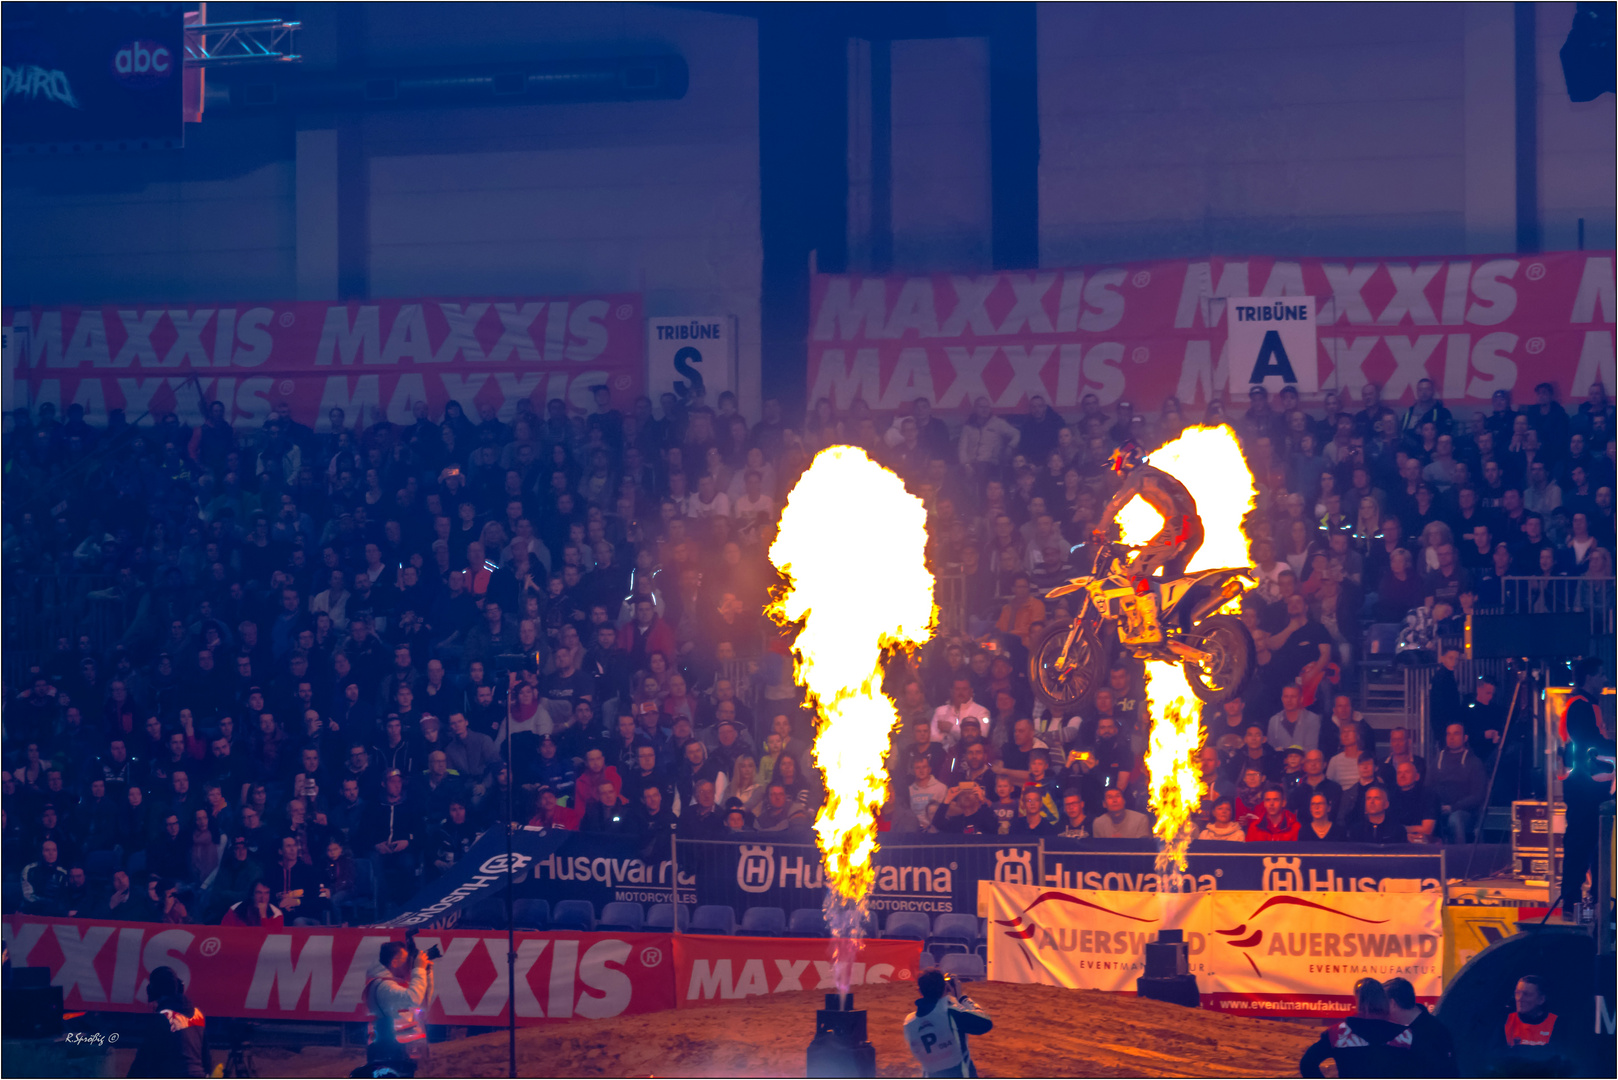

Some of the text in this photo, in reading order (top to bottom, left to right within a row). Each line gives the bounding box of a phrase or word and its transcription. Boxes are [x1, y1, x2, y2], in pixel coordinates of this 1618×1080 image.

[115, 41, 169, 73] abc
[813, 268, 1128, 341] MAXXIS
[1236, 301, 1308, 321] TRIBÜNE
[12, 307, 276, 368] MAXXIS
[314, 300, 611, 366] MAXXIS
[656, 320, 720, 340] TRIBÜNE
[673, 346, 704, 399] S
[1176, 331, 1520, 404] MXXIS
[1249, 330, 1298, 384] A
[807, 341, 1126, 410] MAXXIS
[780, 857, 952, 892] Huarna
[866, 900, 953, 913] MOTORCYCLES
[1038, 927, 1206, 955] AUERSWD
[1267, 932, 1438, 958] AUERSWALD
[1309, 964, 1436, 975] EVENTMANUFAKTUR
[920, 1033, 937, 1054] P
